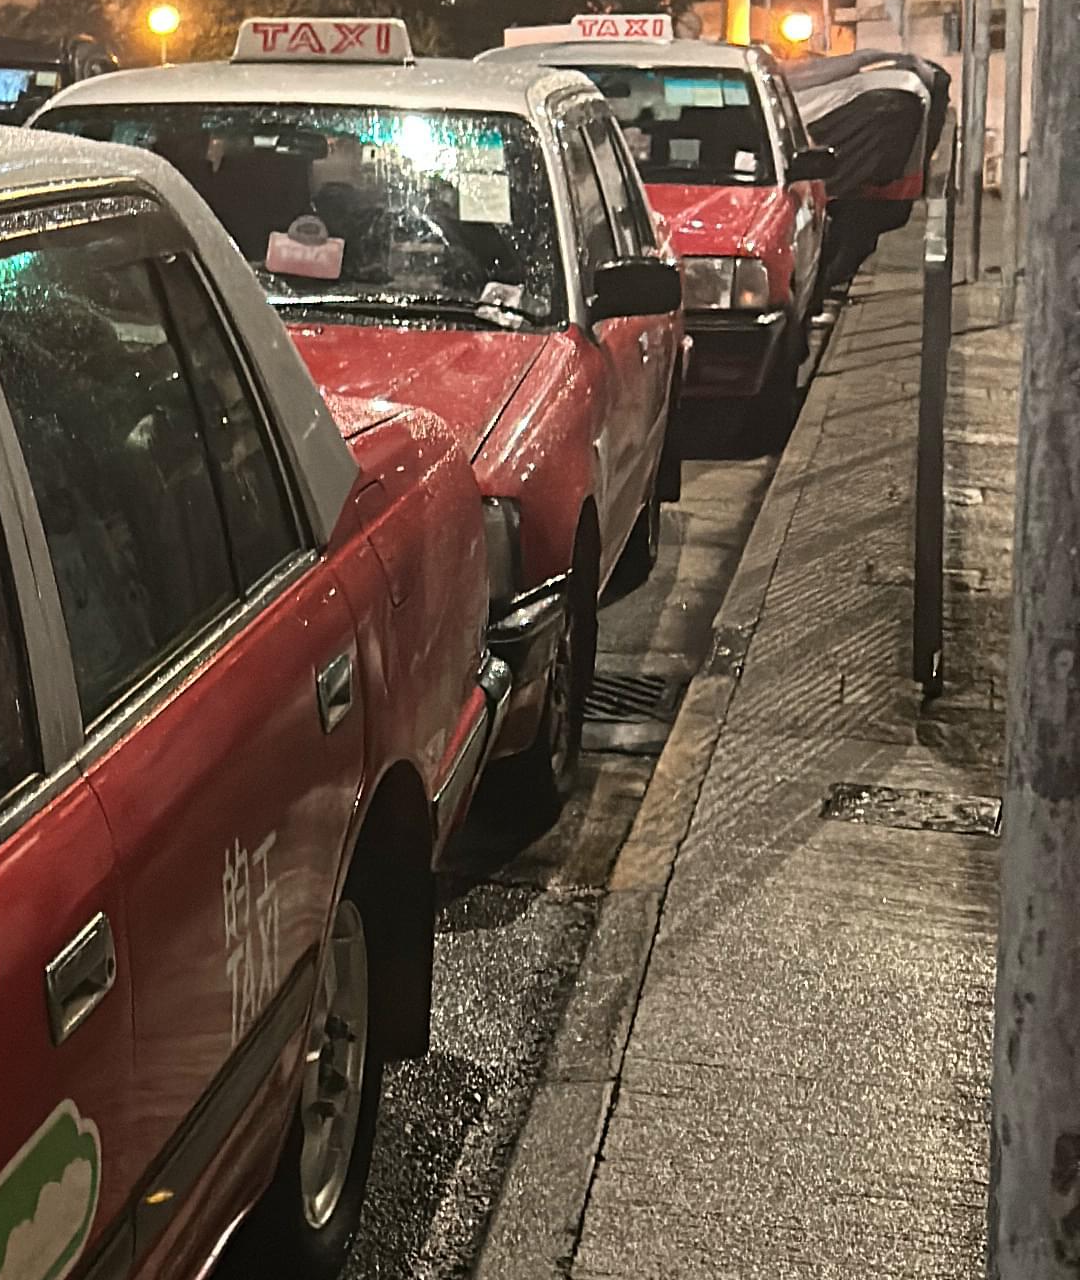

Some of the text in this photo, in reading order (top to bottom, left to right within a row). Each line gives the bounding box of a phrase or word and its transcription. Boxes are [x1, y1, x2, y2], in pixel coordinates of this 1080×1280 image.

[253, 22, 390, 54] TAXI
[578, 19, 664, 37] TAXI
[225, 890, 279, 1049] TAXI
